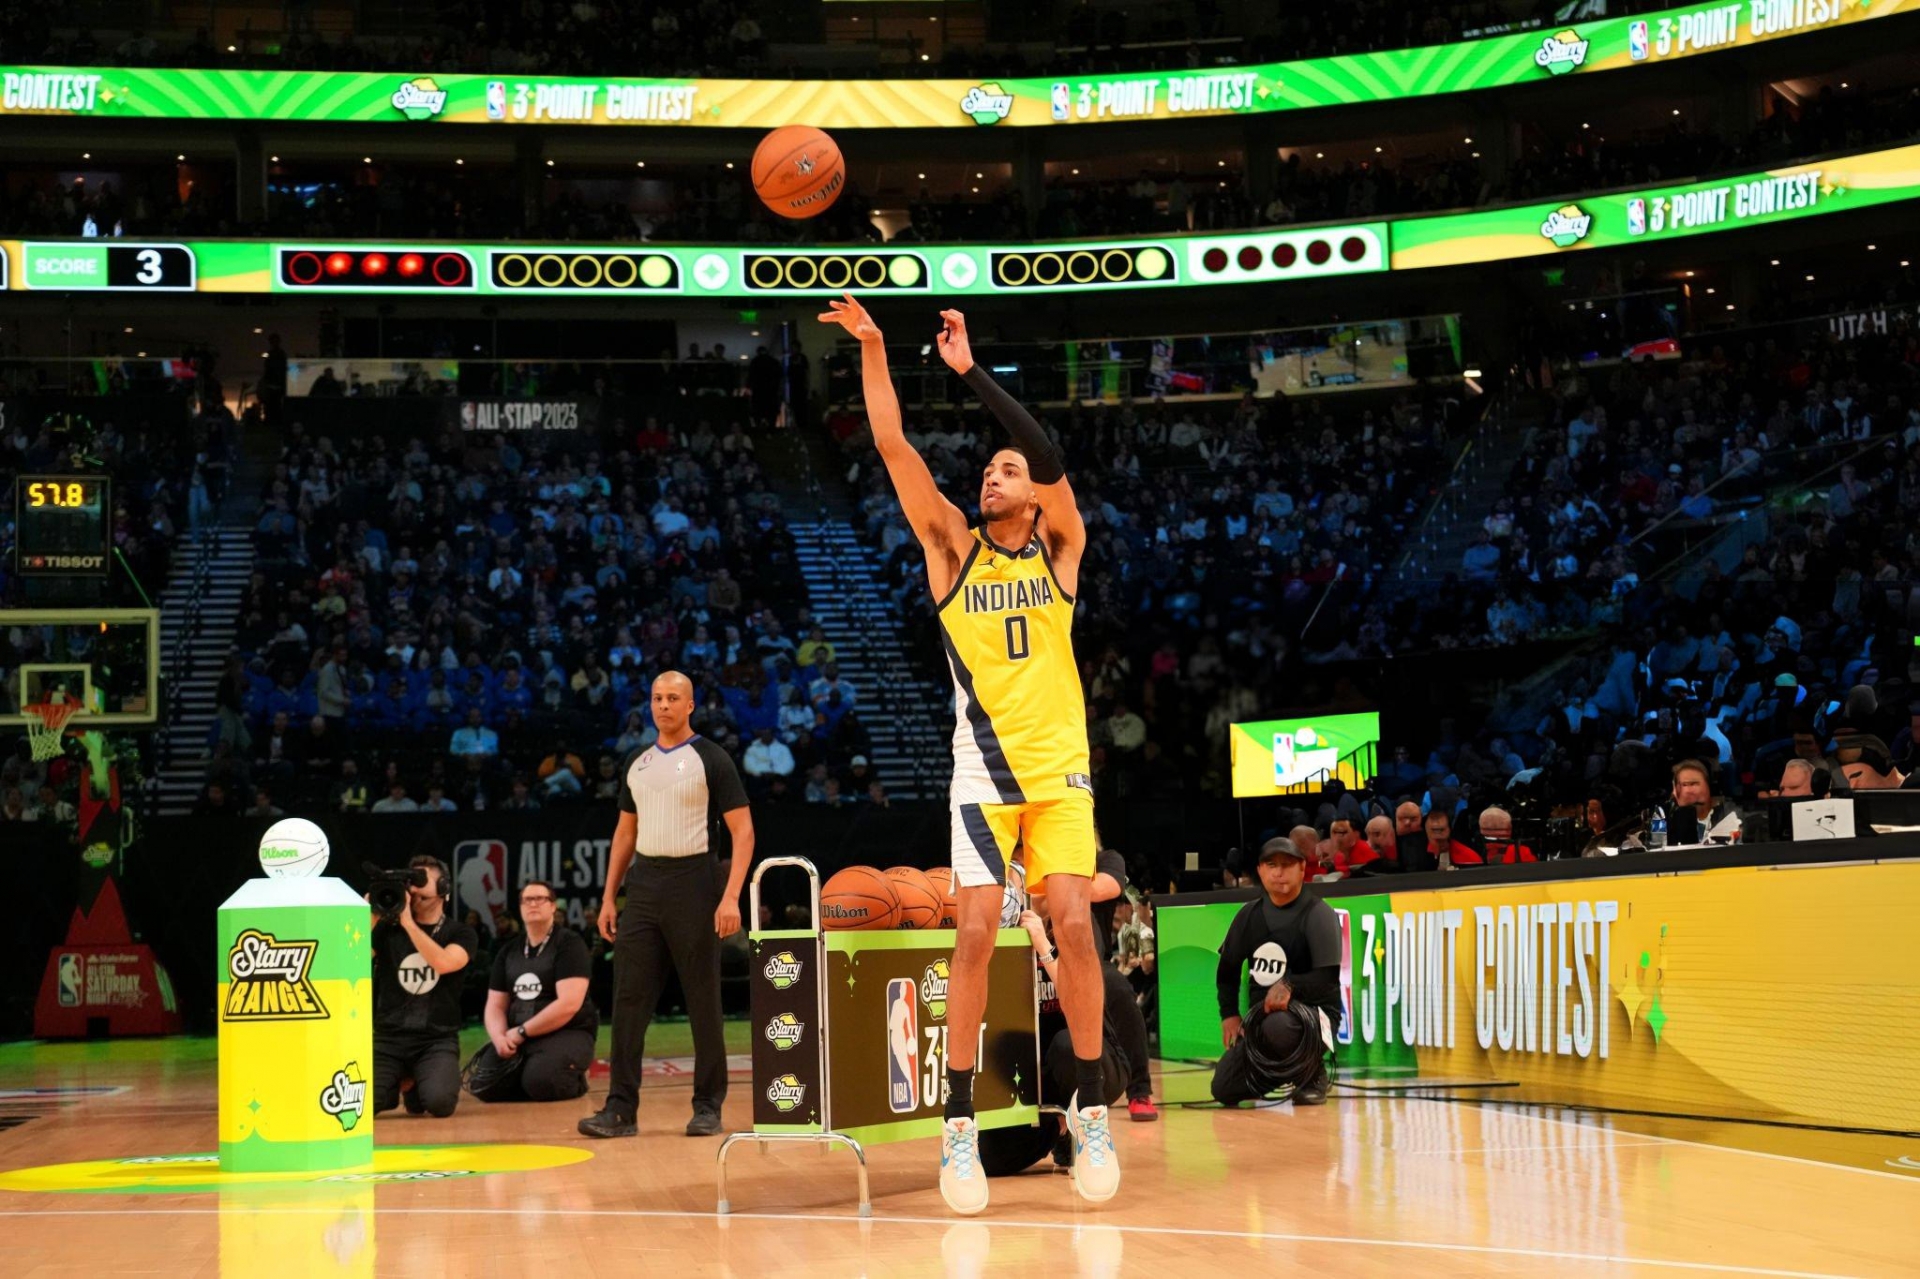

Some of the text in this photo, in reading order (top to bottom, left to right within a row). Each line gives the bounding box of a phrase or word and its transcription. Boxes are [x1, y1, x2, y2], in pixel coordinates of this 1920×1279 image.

[1656, 18, 1672, 56] 3
[1678, 4, 1742, 52] POINT
[2, 73, 102, 110] CONTEST
[513, 83, 699, 121] 3 POINT CONTEST
[1077, 73, 1259, 118] 3 POINT CONTEST
[1650, 171, 1822, 231] 3 POINT CONTEST
[35, 249, 163, 284] SCORE 3
[543, 402, 578, 430] 2023
[29, 483, 83, 507] 57.8
[45, 556, 104, 568] TISSOT
[964, 576, 1054, 613] INDIANA
[1004, 615, 1030, 660] 0
[821, 904, 869, 919] Wilson
[232, 937, 308, 982] Starry
[765, 958, 801, 982] Starry
[227, 980, 318, 1014] RANGE
[1361, 901, 1618, 1058] 3 POINT CONTEST
[767, 1019, 802, 1043] Starry
[923, 1026, 939, 1107] 3
[322, 1072, 366, 1117] Starry
[768, 1080, 804, 1104] Starry
[893, 1082, 909, 1104] NBA
